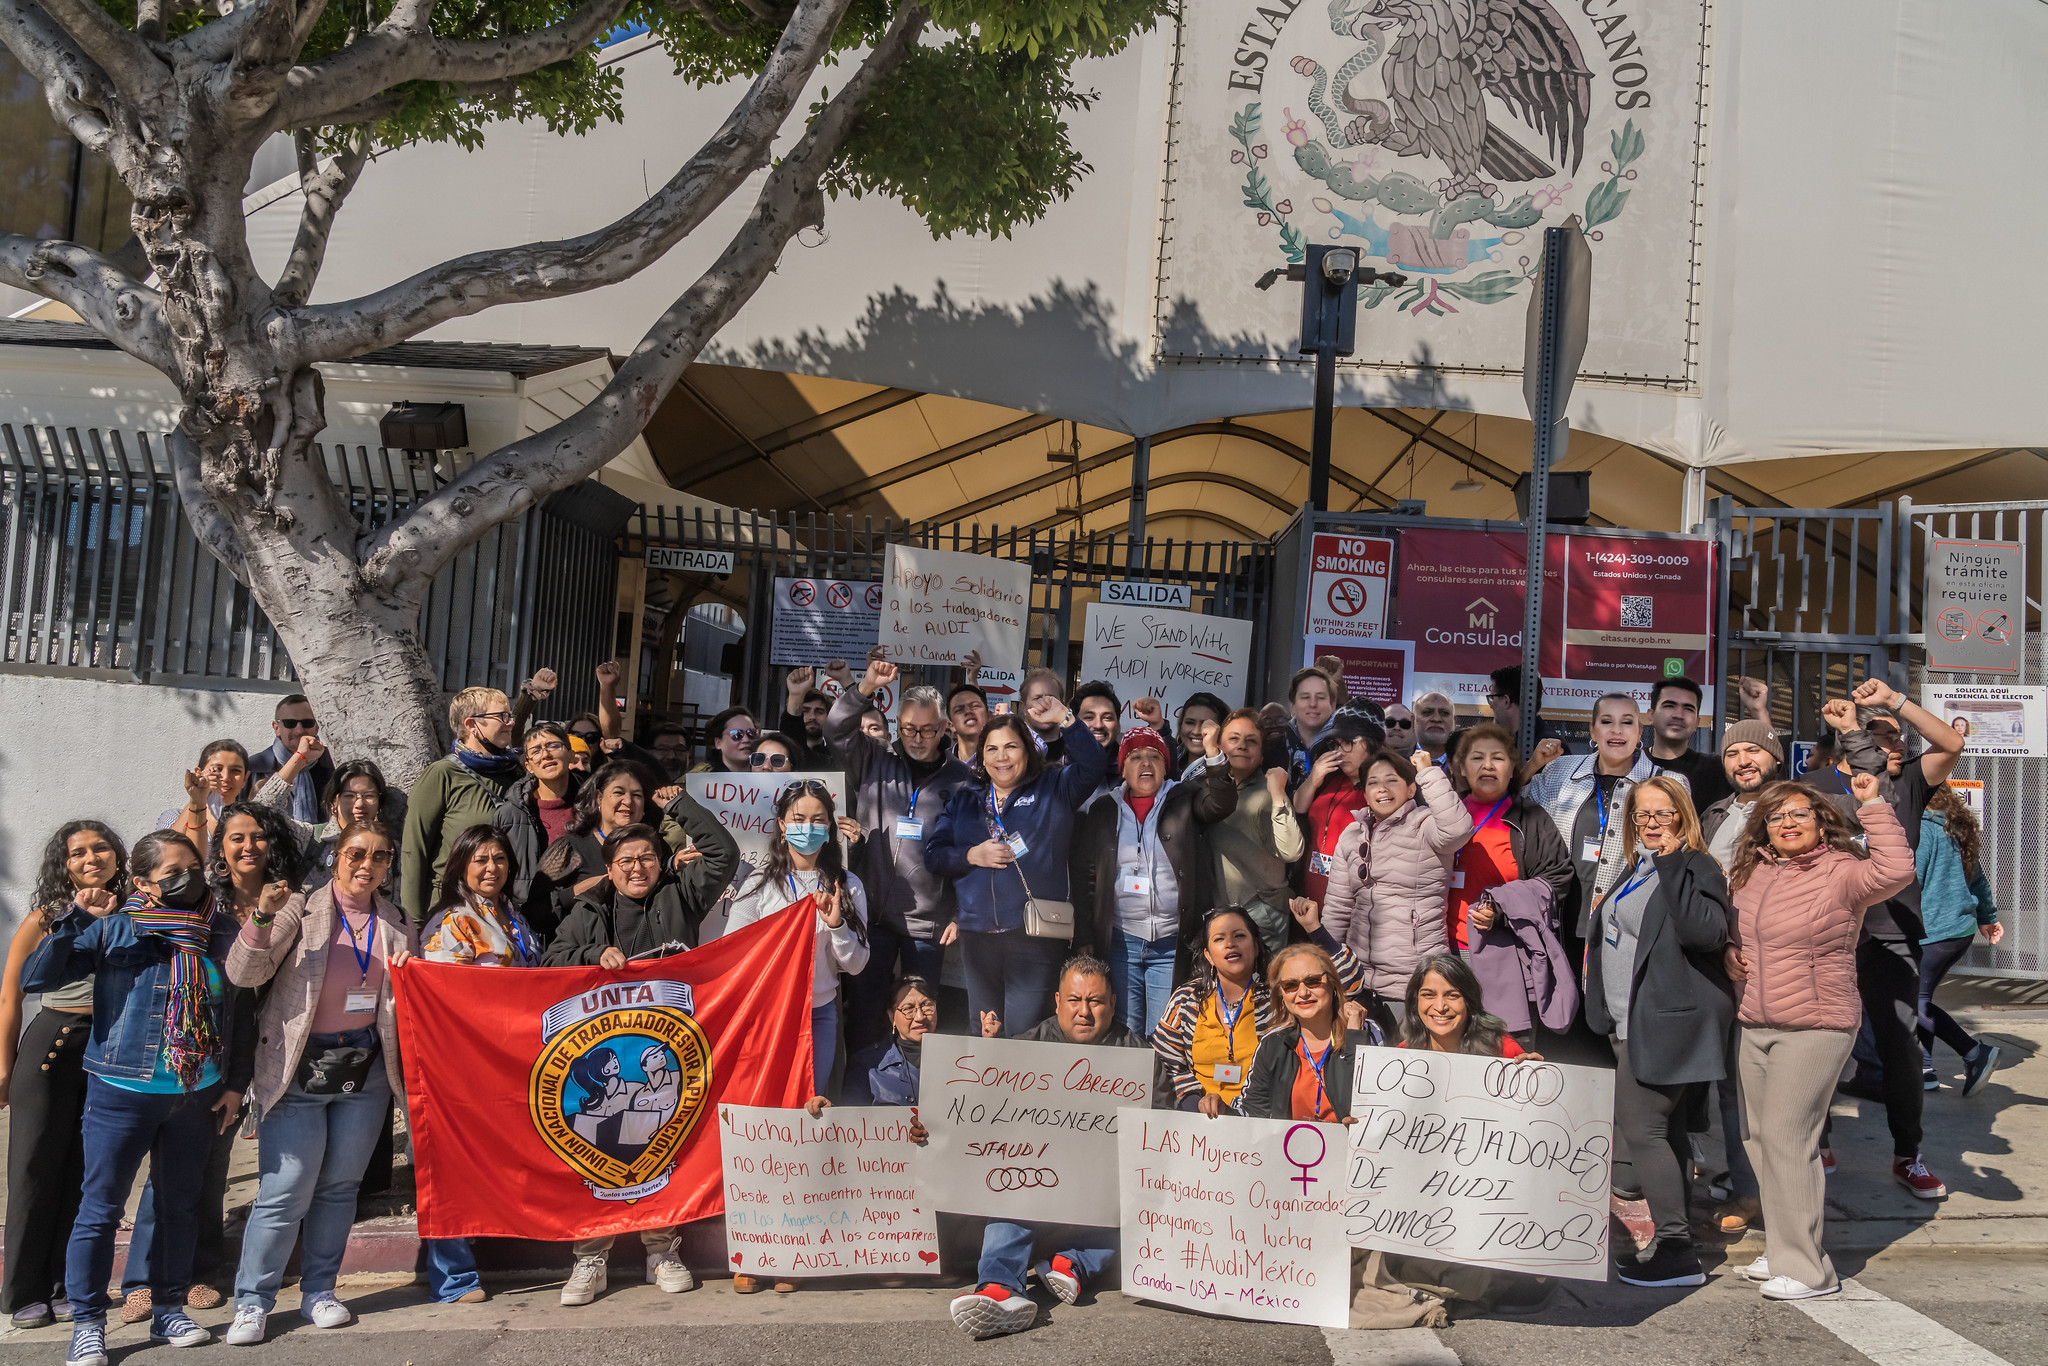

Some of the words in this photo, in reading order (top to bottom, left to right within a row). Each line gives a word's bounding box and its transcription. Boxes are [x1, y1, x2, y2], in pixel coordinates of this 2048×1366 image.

[649, 549, 728, 570] ENTRADA
[1338, 540, 1366, 556] NO
[1585, 552, 1689, 566] 1-(424)-309-0009
[1949, 552, 2001, 567] Ningún
[1316, 555, 1386, 575] SMOKING
[1407, 563, 1437, 573] Ahora,
[1439, 564, 1452, 573] las
[1454, 564, 1476, 574] citas
[1478, 567, 1499, 576] para
[1501, 567, 1517, 576] tus
[1593, 570, 1621, 578] Estados
[1622, 572, 1647, 580] Unidos
[1654, 573, 1682, 581] Canada
[1945, 565, 2008, 579] trámite
[950, 575, 1024, 605] Solidario
[1416, 575, 1466, 584] consulares
[1468, 575, 1494, 585] serán
[1979, 581, 2005, 589] oficina
[1108, 583, 1183, 604] SALIDA
[1942, 589, 2008, 602] requiere
[890, 600, 900, 612] a
[909, 598, 933, 613] los
[941, 598, 1019, 627] trabajadores
[1312, 617, 1344, 627] WITHIN
[1345, 621, 1355, 629] 25
[1357, 621, 1379, 631] FEET
[1469, 612, 1494, 629] Mi
[893, 620, 909, 635] de
[925, 620, 970, 636] AUDI
[1095, 614, 1126, 643] WE
[1137, 615, 1187, 649] STAND
[1314, 626, 1327, 634] OF
[1328, 628, 1373, 639] DOORWAY
[1425, 627, 1522, 647] Consulad
[1600, 634, 1671, 645] citas.sre.gob.mx
[920, 644, 956, 661] Canada
[1346, 659, 1399, 669] IMPORTANTE
[1160, 660, 1234, 688] WORKERS
[1148, 685, 1168, 699] IN
[1541, 687, 1604, 699] XTERIORES
[719, 810, 775, 834] SINAC
[582, 984, 655, 1014] UNTA
[568, 1012, 691, 1052] TRABAJADORES
[557, 1047, 574, 1071] DE
[684, 1040, 701, 1073] POR
[1356, 1052, 1436, 1100] LOS
[542, 1073, 569, 1140] NACIONAL
[649, 1074, 702, 1158] APLICACIÓN
[947, 1094, 986, 1126] NO
[731, 1112, 798, 1148] Lucha,
[800, 1117, 862, 1149] Lucha,
[564, 1138, 609, 1172] UNIÓN
[1142, 1121, 1181, 1154] LAS
[1191, 1134, 1263, 1173] Mujeres
[1352, 1104, 1610, 1194] TRABAJADORES
[733, 1155, 755, 1174] no
[761, 1153, 810, 1184] dejen
[821, 1156, 848, 1176] de
[857, 1156, 910, 1174] luchar
[1350, 1156, 1394, 1189] DE
[1419, 1170, 1516, 1201] AUDI
[729, 1183, 770, 1205] Desde
[782, 1191, 796, 1206] el
[803, 1187, 863, 1205] encuentro
[1135, 1168, 1235, 1206] Trabajadoras
[729, 1211, 747, 1226] en
[753, 1209, 774, 1227] Los
[781, 1212, 827, 1232] Angeles,
[862, 1207, 901, 1226] Apoyo
[1138, 1209, 1214, 1238] apoyamos
[1229, 1215, 1247, 1245] la
[1263, 1223, 1312, 1251] lucha
[1344, 1199, 1457, 1247] SOMOS
[1479, 1212, 1608, 1262] TODOS!
[731, 1228, 815, 1247] incondicional.
[841, 1229, 862, 1243] los
[868, 1227, 937, 1244] compañeros
[757, 1251, 778, 1268] de
[854, 1248, 911, 1267] MÉXICO
[1139, 1238, 1165, 1262] de
[1180, 1239, 1317, 1287] #AudiMéxico
[1132, 1263, 1173, 1293] Canada
[1189, 1278, 1218, 1301] USA
[1239, 1287, 1300, 1310] México
